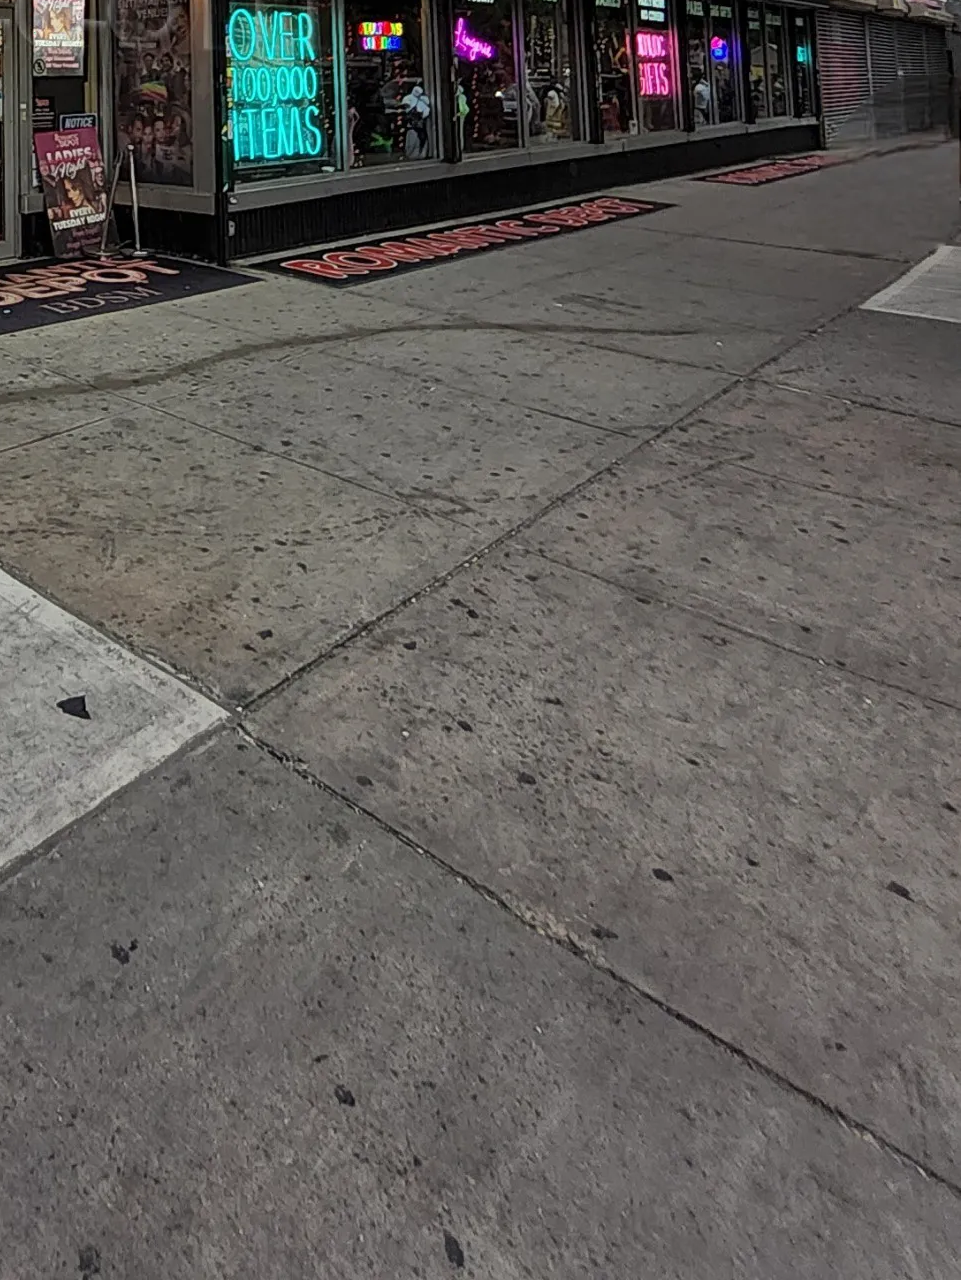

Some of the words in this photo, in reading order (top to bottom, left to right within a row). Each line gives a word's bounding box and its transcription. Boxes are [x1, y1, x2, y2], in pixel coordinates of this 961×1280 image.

[228, 7, 316, 62] OVER
[454, 17, 493, 61] Lingerie
[228, 66, 318, 107] 100,000
[64, 116, 94, 129] NOTICE
[231, 104, 322, 161] ITEMS
[46, 146, 92, 162] LADIES
[52, 217, 86, 231] TUESDAY
[279, 219, 561, 280] ROMANTIC
[39, 285, 165, 315] BDSM
